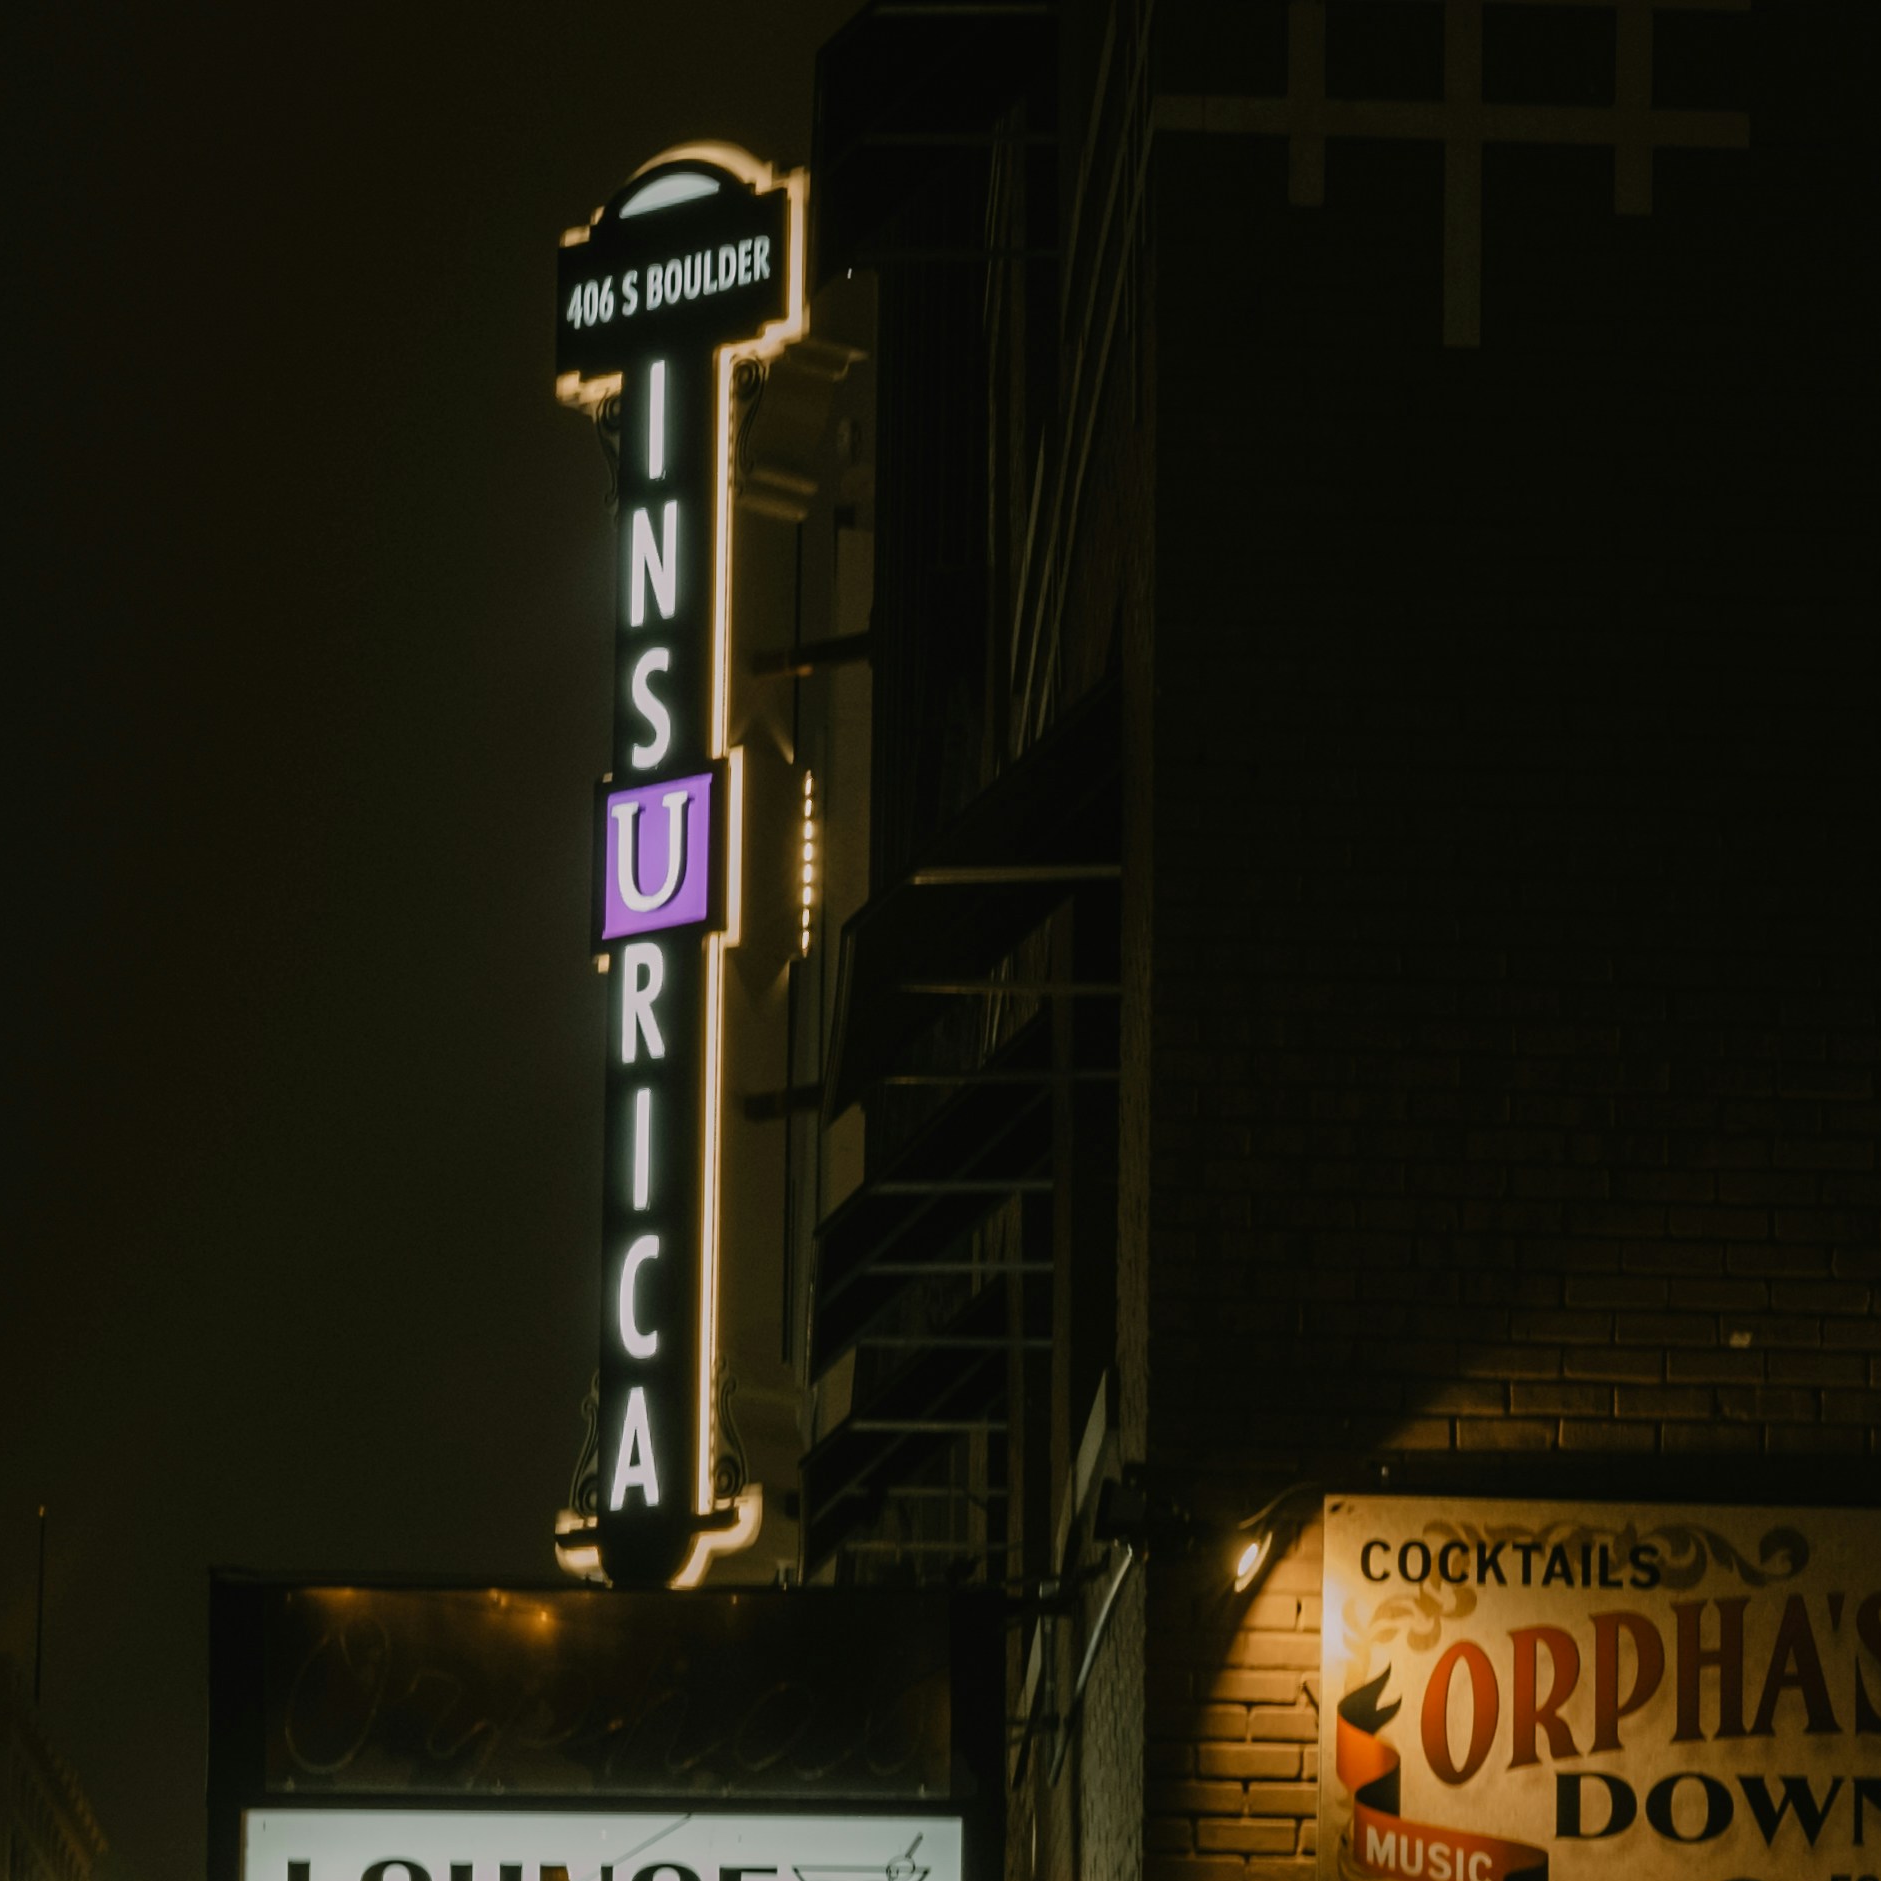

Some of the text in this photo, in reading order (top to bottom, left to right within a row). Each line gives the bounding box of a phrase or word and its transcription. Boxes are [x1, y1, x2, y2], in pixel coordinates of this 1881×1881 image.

[566, 234, 772, 331] 406 S BOULDER
[608, 358, 692, 1513] INSURICA
[1359, 1539, 1663, 1589] COCKTAILS
